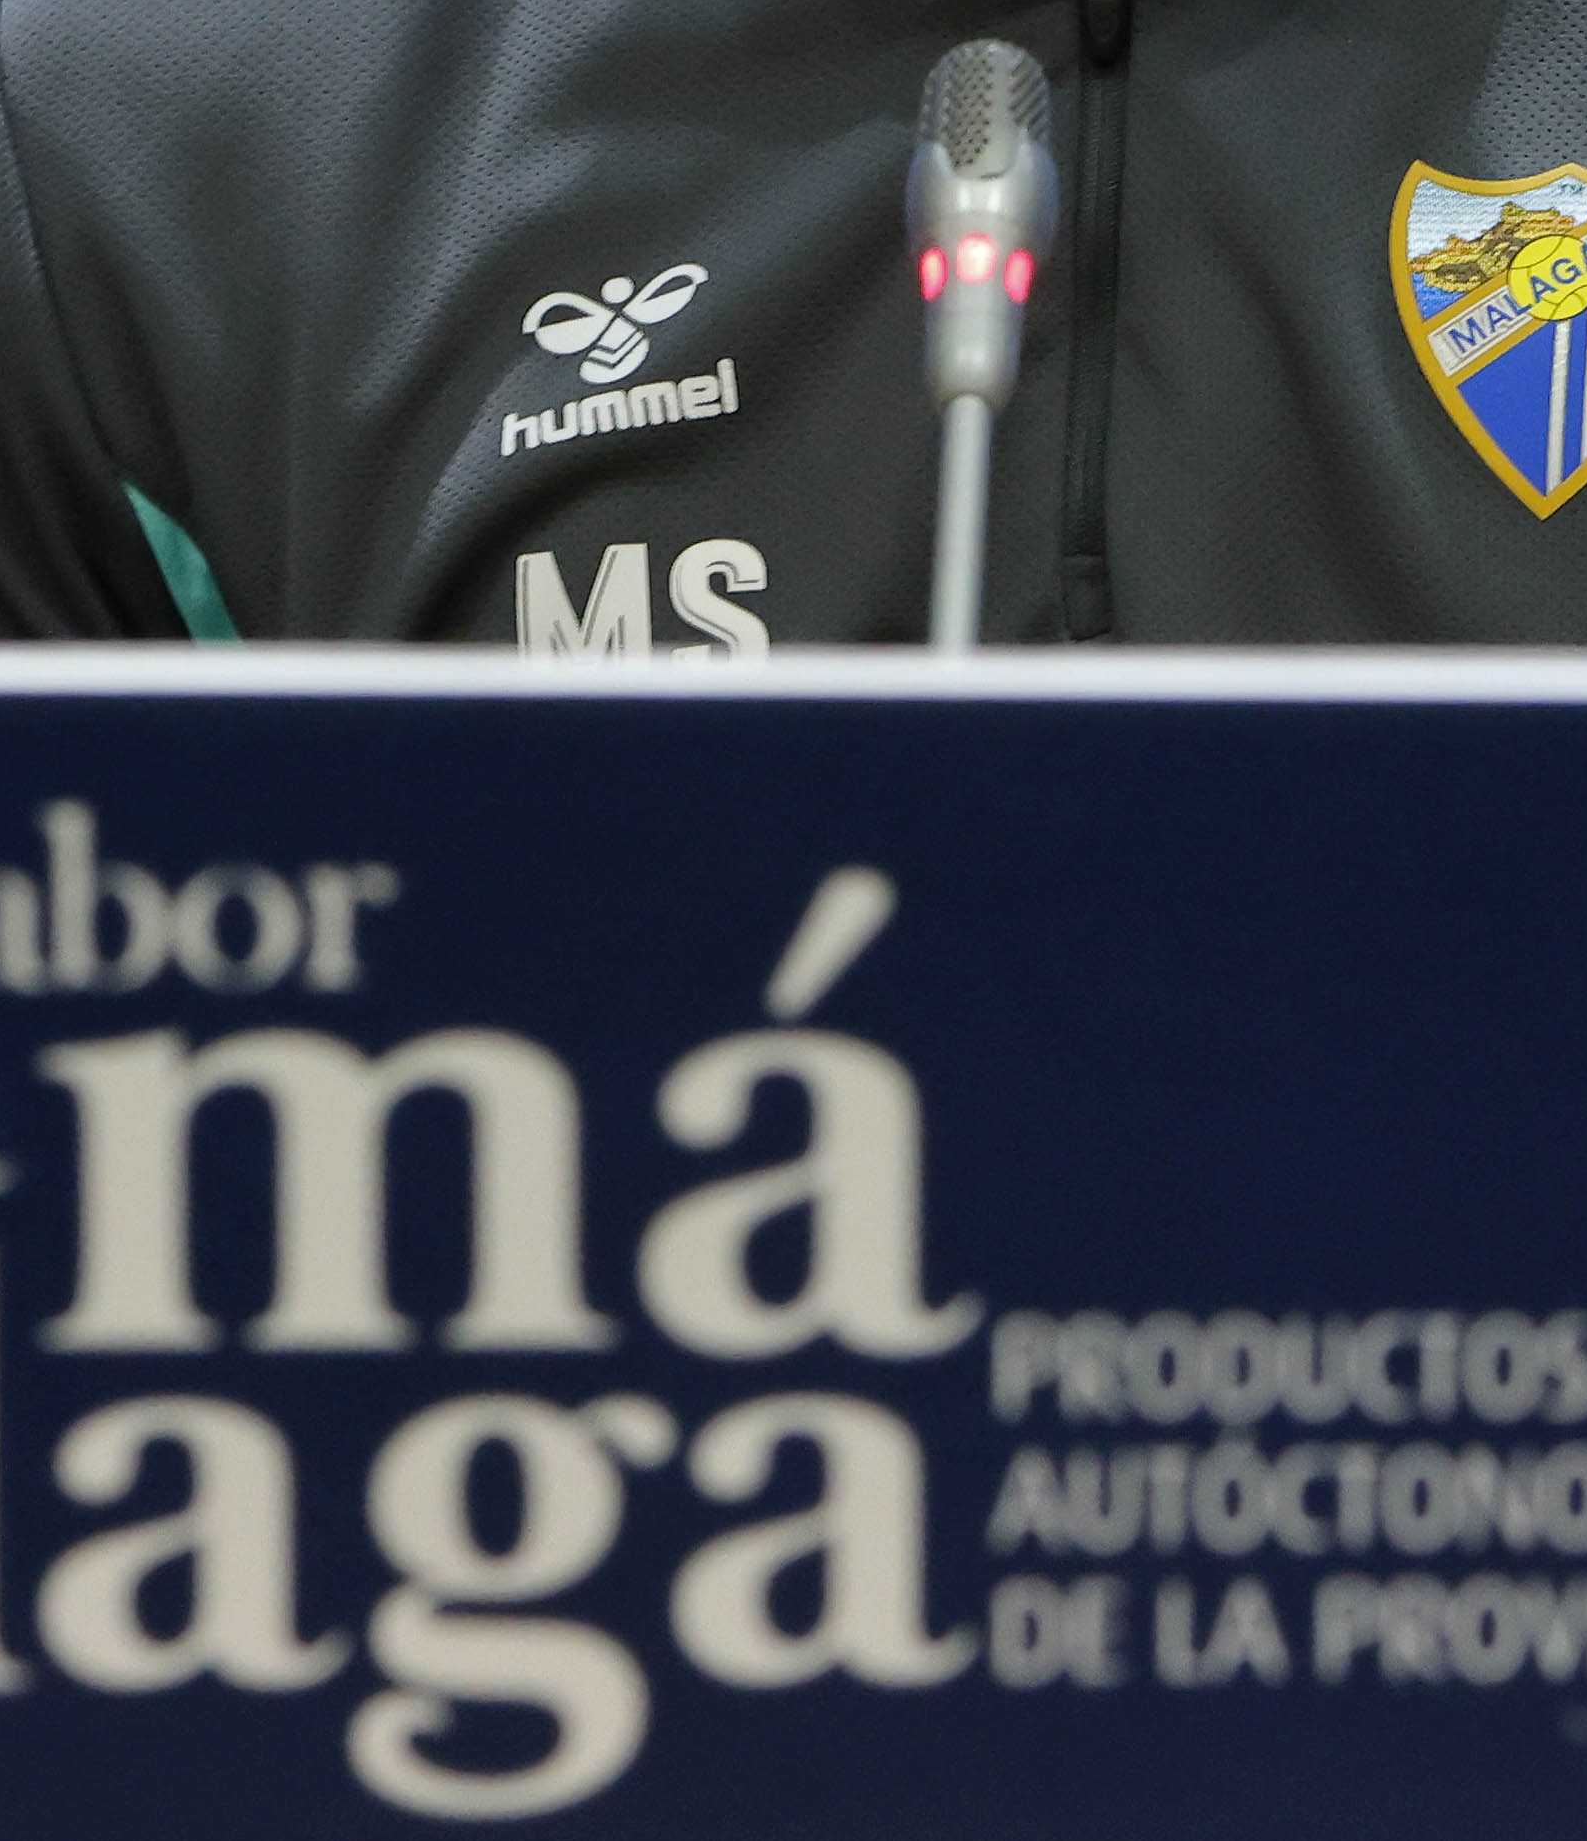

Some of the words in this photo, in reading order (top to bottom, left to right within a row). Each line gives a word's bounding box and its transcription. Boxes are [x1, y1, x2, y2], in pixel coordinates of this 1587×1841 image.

[499, 359, 738, 457] hummel
[515, 539, 769, 654] MS
[47, 869, 977, 1358] má
[987, 1574, 1121, 1691] DE
[1151, 1577, 1295, 1689] LA
